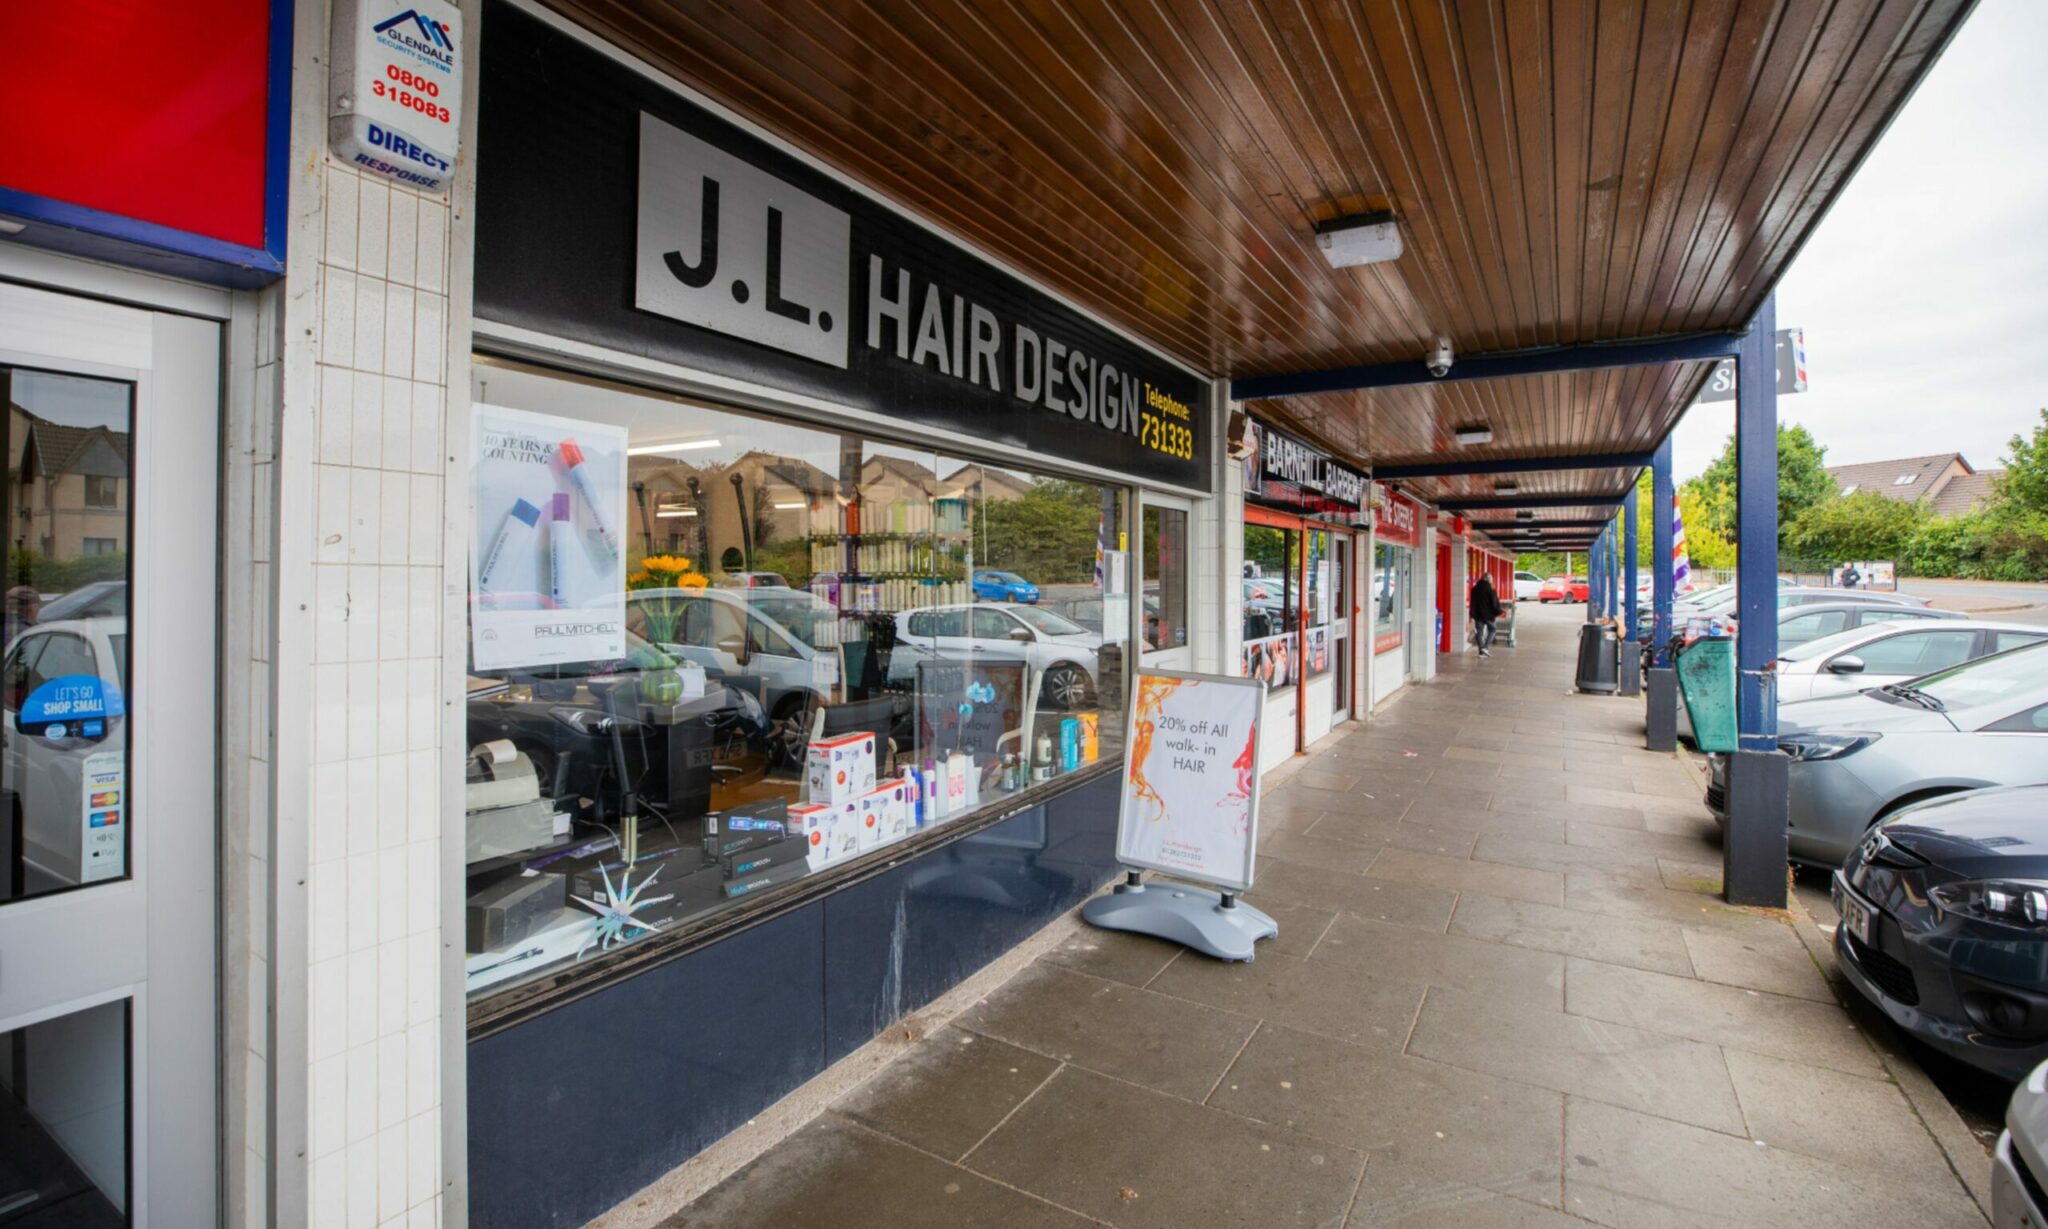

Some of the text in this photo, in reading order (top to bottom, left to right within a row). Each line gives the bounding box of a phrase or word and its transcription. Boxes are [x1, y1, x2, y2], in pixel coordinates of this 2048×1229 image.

[376, 35, 451, 74] SECURITY SYSTEMS
[388, 28, 453, 66] GLENDALE
[387, 64, 439, 97] 0800
[373, 80, 450, 124] 318083
[368, 123, 450, 172] DIRECT
[355, 153, 440, 189] RESPONSE
[662, 175, 1139, 438] J.L. HAIR DESIGN
[1145, 382, 1190, 420] Telephone:
[502, 437, 540, 452] YEARS
[1141, 412, 1193, 460] 731333
[1267, 431, 1324, 491] BARNHILL
[535, 623, 617, 636] PAUL MITCHELL
[43, 698, 104, 715] SHOP SMALL
[55, 685, 94, 700] LET'S GO
[1159, 716, 1228, 738] 20% off All
[1165, 738, 1216, 756] walk- in
[1173, 757, 1205, 774] HAIR
